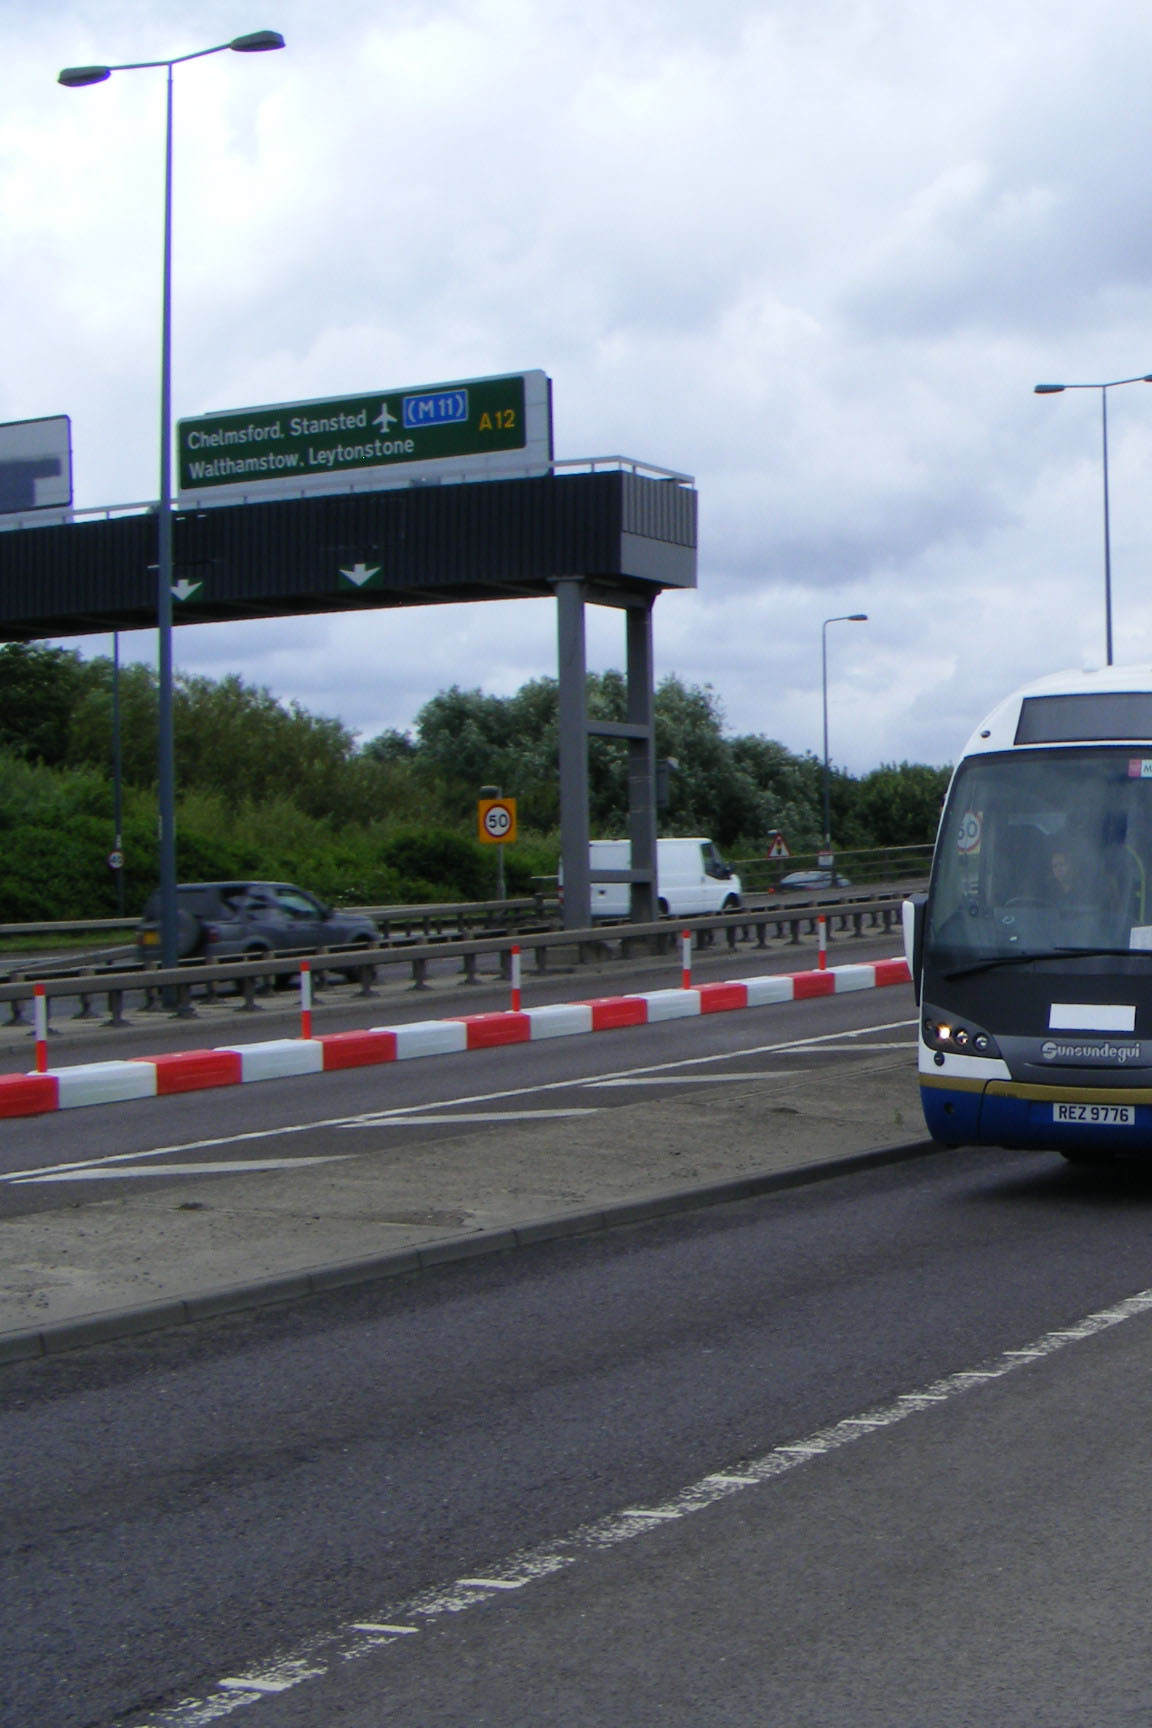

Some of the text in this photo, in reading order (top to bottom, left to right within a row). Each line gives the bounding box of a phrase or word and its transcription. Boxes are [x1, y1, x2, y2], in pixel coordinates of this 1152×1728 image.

[289, 409, 367, 437] Stansted
[479, 408, 516, 432] A12
[308, 438, 415, 467] Leytonstone
[488, 813, 508, 829] 50
[1042, 1041, 1140, 1064] Sunsundegui
[1058, 1104, 1129, 1123] REZ 9776
